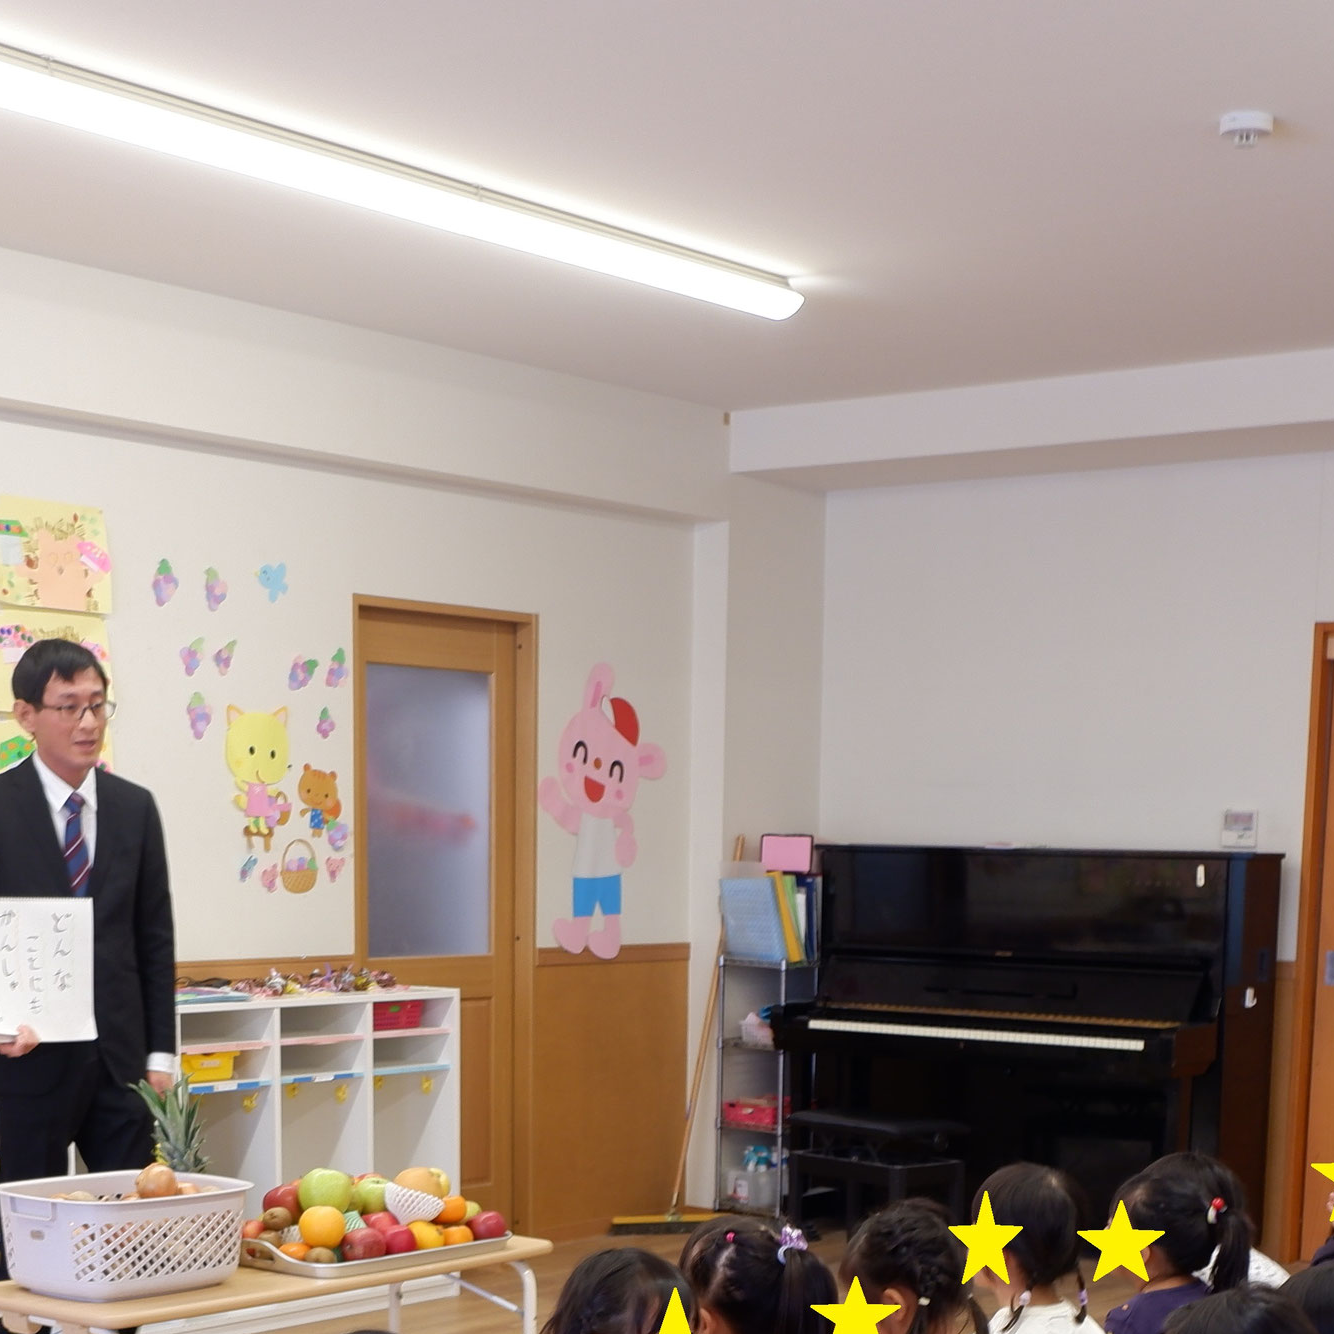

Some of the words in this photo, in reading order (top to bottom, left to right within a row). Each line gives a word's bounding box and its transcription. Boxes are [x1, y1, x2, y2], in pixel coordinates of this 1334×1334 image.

[26, 935, 44, 1015] ことにも
[51, 911, 72, 991] どんな
